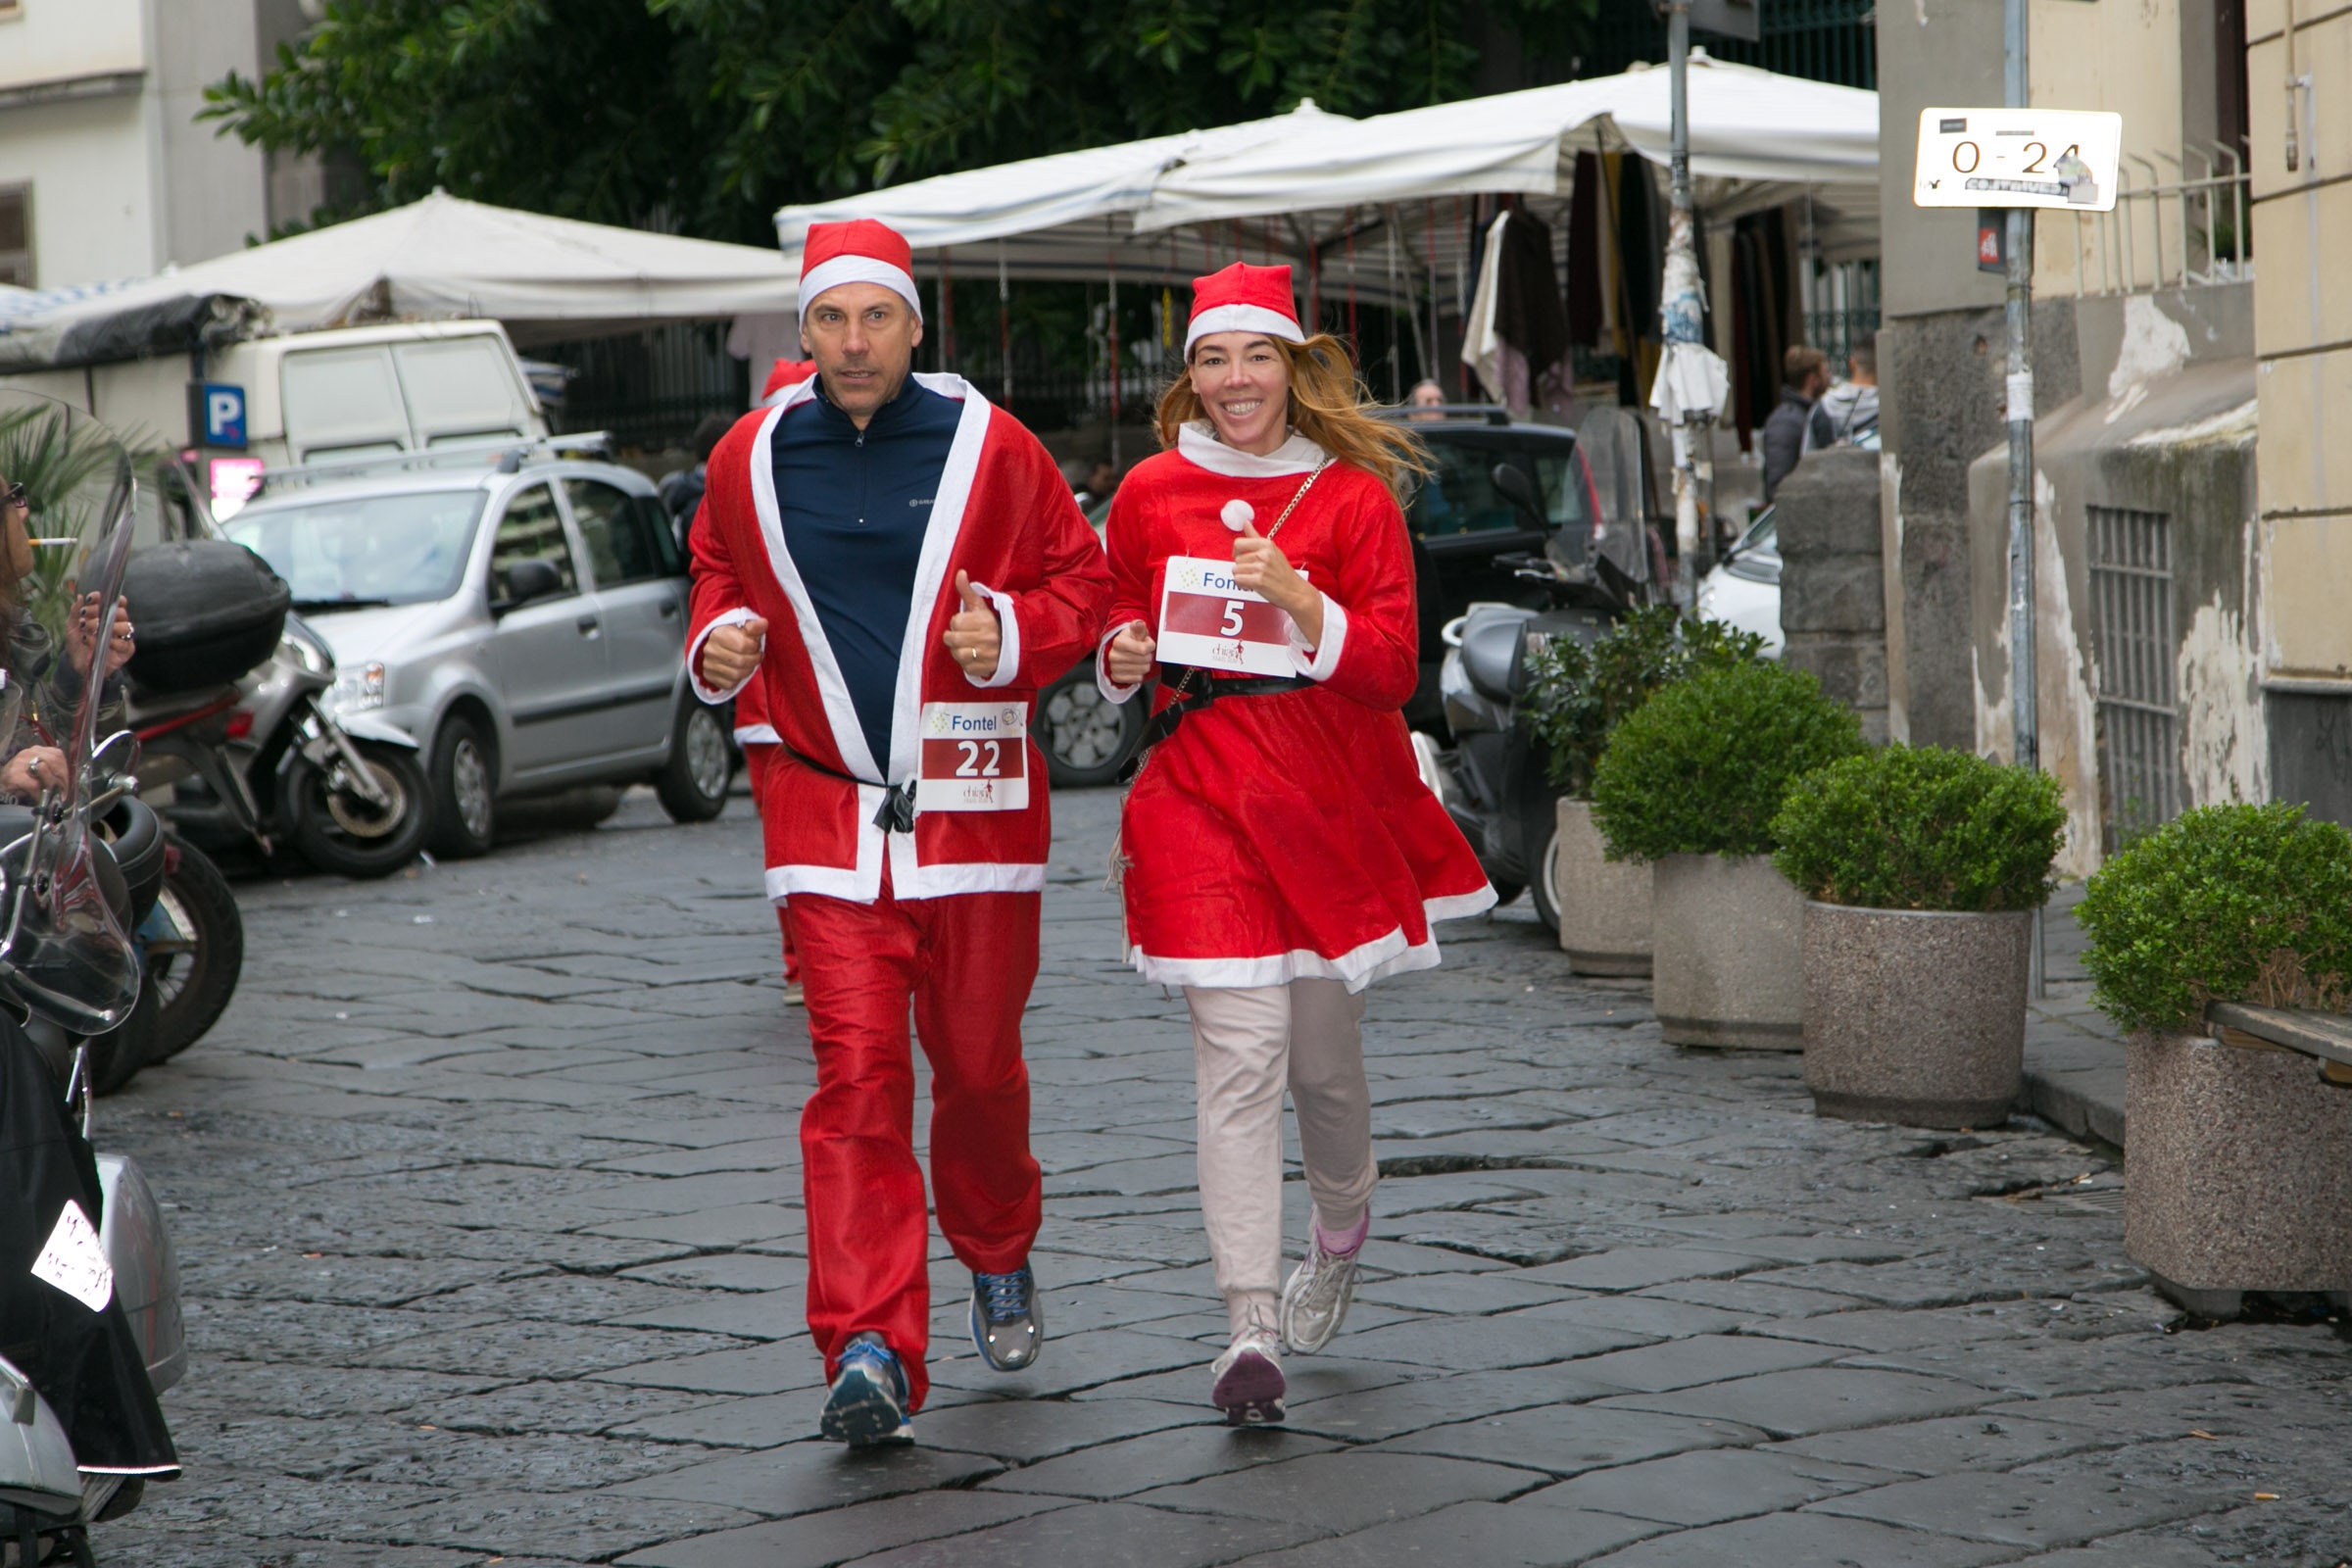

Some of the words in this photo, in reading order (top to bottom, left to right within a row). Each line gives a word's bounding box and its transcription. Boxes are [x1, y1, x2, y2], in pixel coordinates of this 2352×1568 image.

[208, 392, 242, 436] P
[1203, 571, 1254, 592] Fon
[1219, 600, 1245, 637] 5
[952, 715, 998, 731] Fontel
[956, 740, 1001, 777] 22
